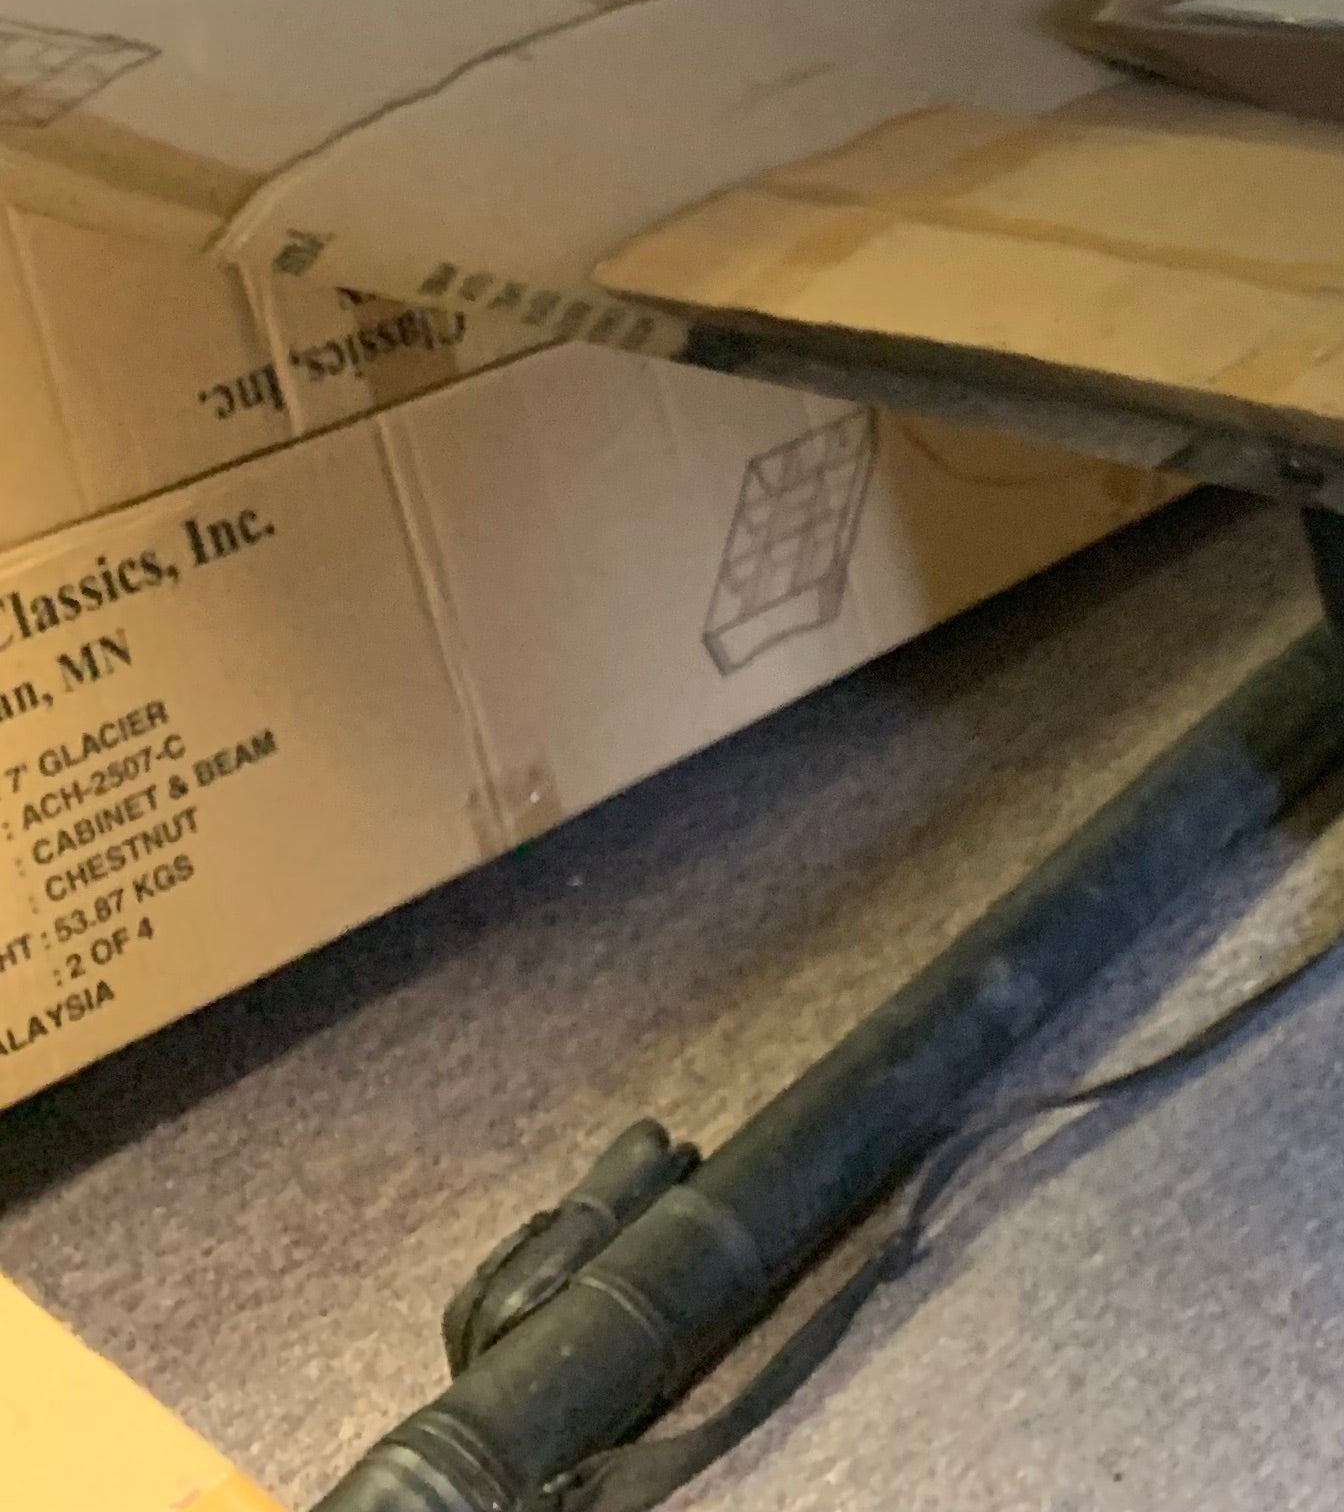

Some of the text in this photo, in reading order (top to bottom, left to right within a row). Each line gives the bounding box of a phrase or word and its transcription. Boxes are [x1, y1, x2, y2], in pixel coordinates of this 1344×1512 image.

[198, 364, 282, 419] Inc.
[183, 507, 276, 568] Inc.
[57, 626, 132, 692] MN
[38, 700, 169, 778] GLACIER
[22, 733, 186, 831] ACH-2507-C
[31, 783, 158, 865] CABINET
[168, 773, 190, 800] &
[192, 728, 278, 788] BEAM
[44, 805, 199, 902] CHESTNUT
[53, 887, 125, 944] 53.87
[132, 853, 196, 904] KGS
[65, 952, 86, 980] 2
[90, 926, 131, 966] OF
[136, 915, 155, 941] 4
